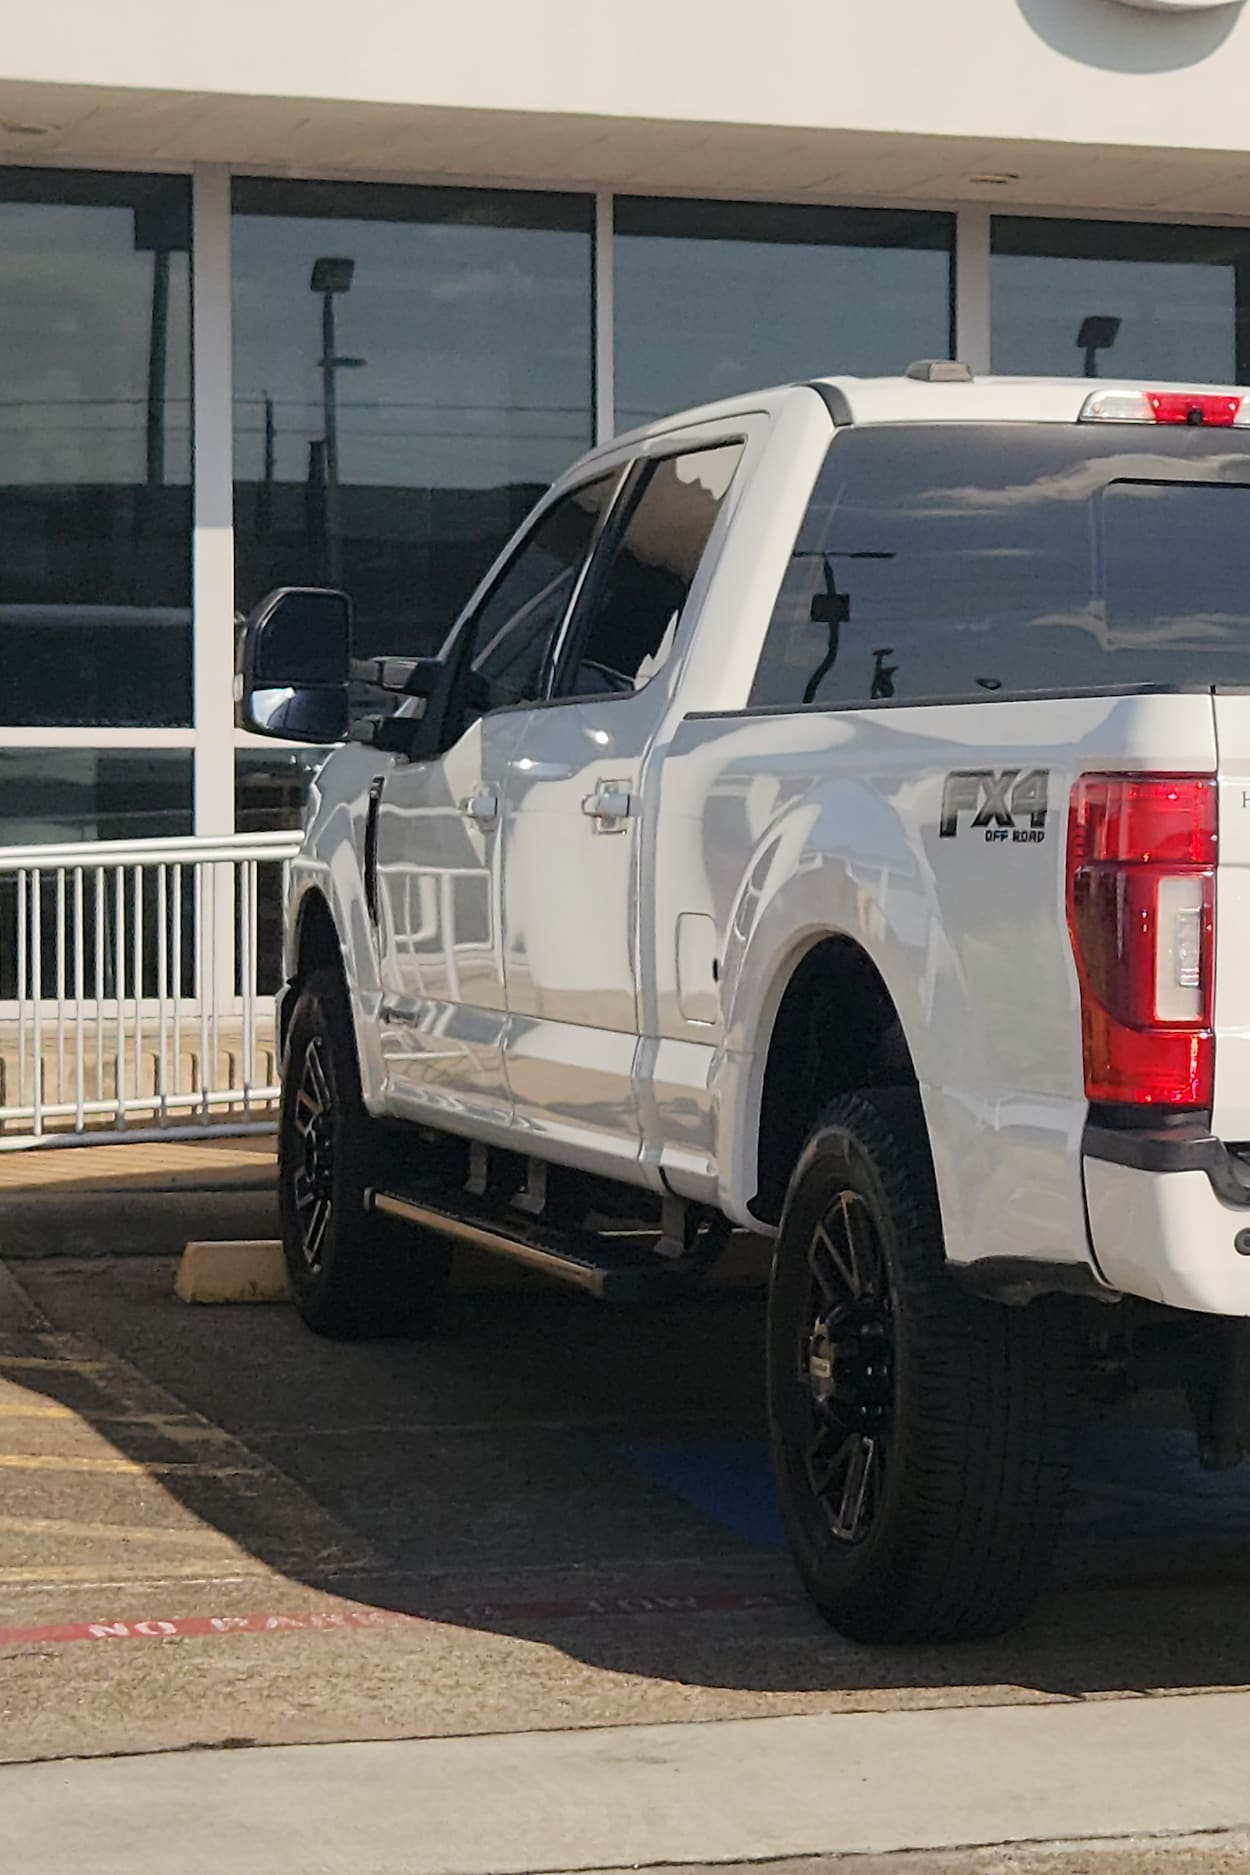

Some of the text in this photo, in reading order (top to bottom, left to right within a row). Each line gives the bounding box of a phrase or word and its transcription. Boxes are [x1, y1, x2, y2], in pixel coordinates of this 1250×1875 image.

[939, 769, 1050, 838] FX4
[984, 830, 1045, 843] OFF ROAD
[88, 1621, 177, 1639] NO
